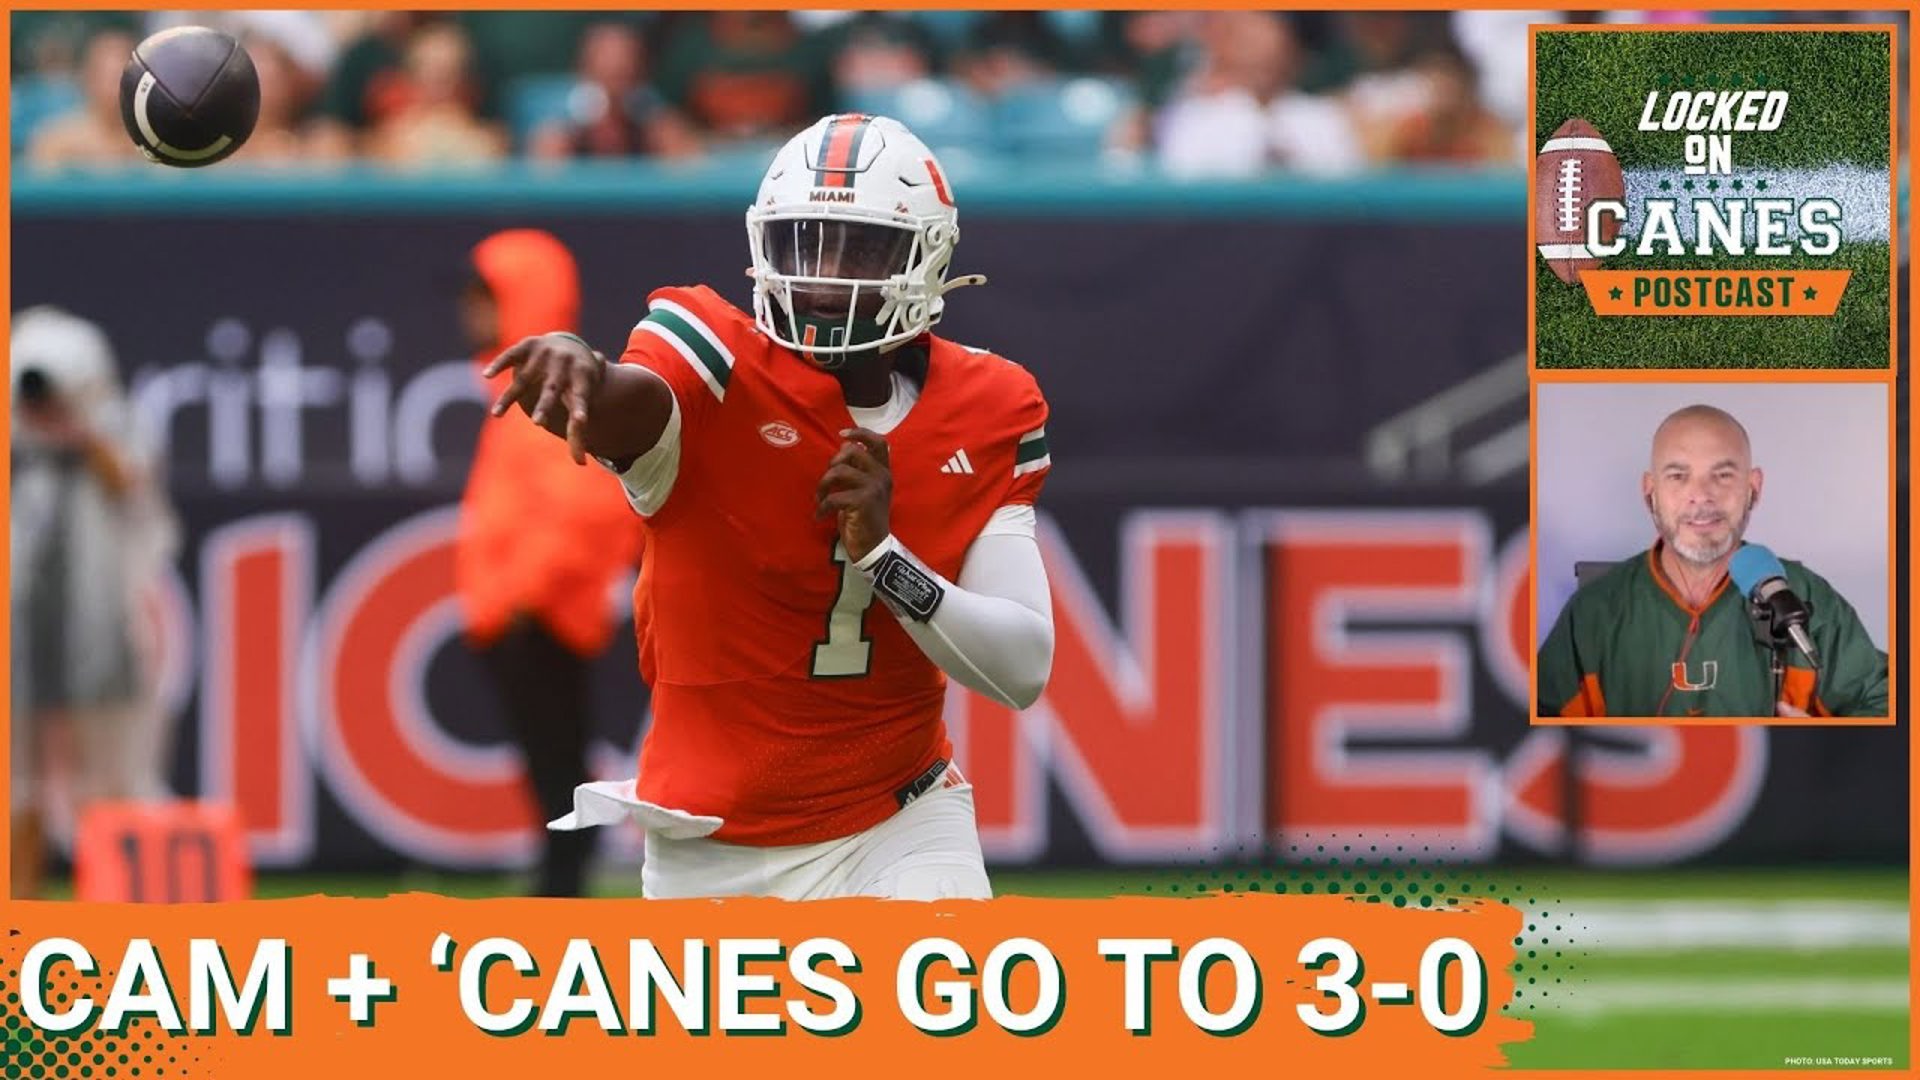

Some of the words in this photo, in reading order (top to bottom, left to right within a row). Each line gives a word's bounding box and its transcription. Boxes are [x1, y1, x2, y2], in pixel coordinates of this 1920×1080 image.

[809, 190, 855, 204] MIAMI
[811, 538, 874, 679] 1
[1672, 661, 1717, 690] U
